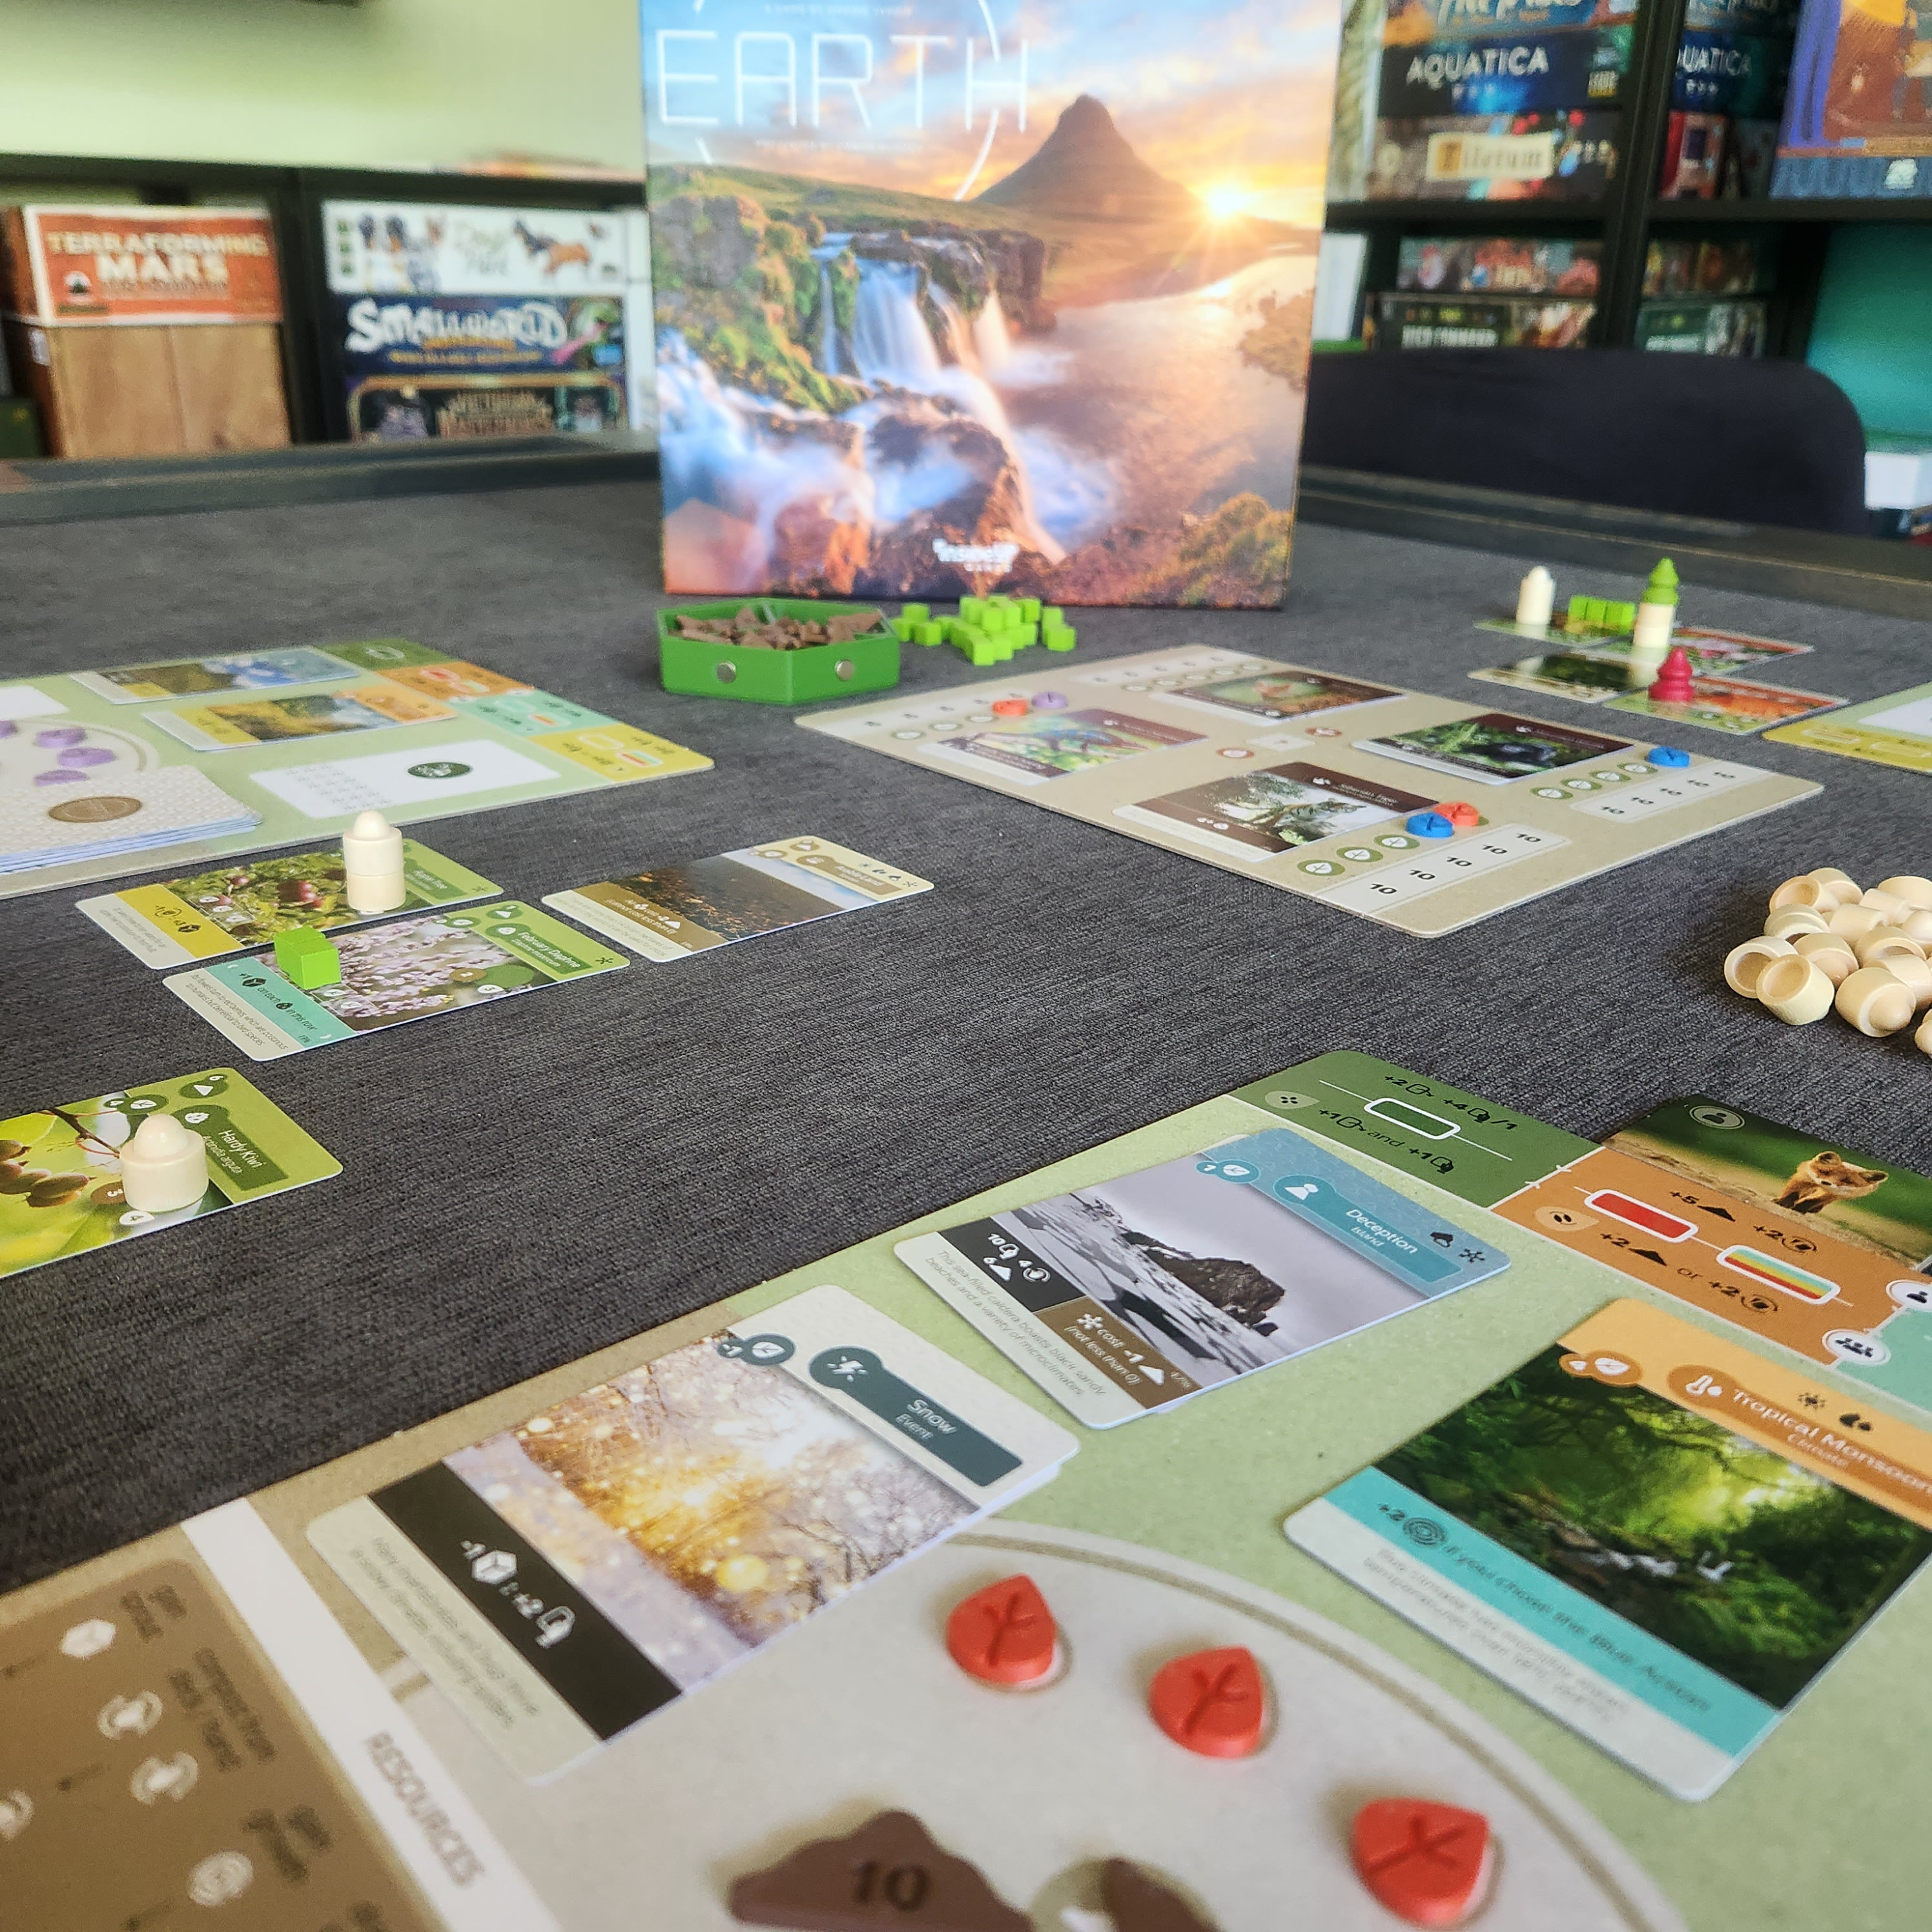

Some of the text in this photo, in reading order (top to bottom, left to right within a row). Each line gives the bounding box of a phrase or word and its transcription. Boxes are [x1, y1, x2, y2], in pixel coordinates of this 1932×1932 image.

[1406, 46, 1549, 90] AQUATICA
[657, 29, 1028, 134] EARTH
[47, 232, 269, 257] TERRAFORMING
[97, 253, 229, 283] MARS
[1482, 844, 1507, 854] 10
[1516, 833, 1541, 843] 10
[1446, 856, 1472, 867] 10
[1409, 870, 1435, 880] 10
[1370, 883, 1397, 894] 10
[264, 992, 281, 1003] each
[291, 1012, 305, 1022] this
[300, 1020, 317, 1030] row
[1384, 1076, 1408, 1086] +2
[1319, 1109, 1341, 1119] +1
[1443, 1099, 1468, 1110] +4
[218, 1129, 267, 1169] Hardy Kiwi
[1367, 1131, 1433, 1159] and +1
[1670, 1191, 1699, 1204] +5
[988, 1233, 1005, 1245] 10
[1346, 1209, 1417, 1253] Deception
[1351, 1226, 1384, 1246] Island
[1601, 1233, 1630, 1248] +2
[1753, 1226, 1783, 1240] +2
[1676, 1268, 1740, 1297] or +2
[925, 1257, 960, 1286] beaches
[956, 1286, 978, 1300] and
[981, 1306, 1012, 1331] variety
[1008, 1331, 1025, 1340] of
[937, 1250, 1105, 1394] This sea-filled caldera boasts black sandy
[1064, 1326, 1140, 1384] (not less than 0)
[1097, 1329, 1144, 1363] cost -1
[896, 1413, 932, 1439] Event
[907, 1399, 955, 1433] Snow
[1733, 1388, 1932, 1495] Tropical Monsoon
[1379, 1503, 1406, 1521] +2
[461, 1540, 485, 1559] -1
[514, 1594, 543, 1618] +2
[362, 1730, 486, 1889] RESOURCES
[852, 1860, 931, 1913] 10
